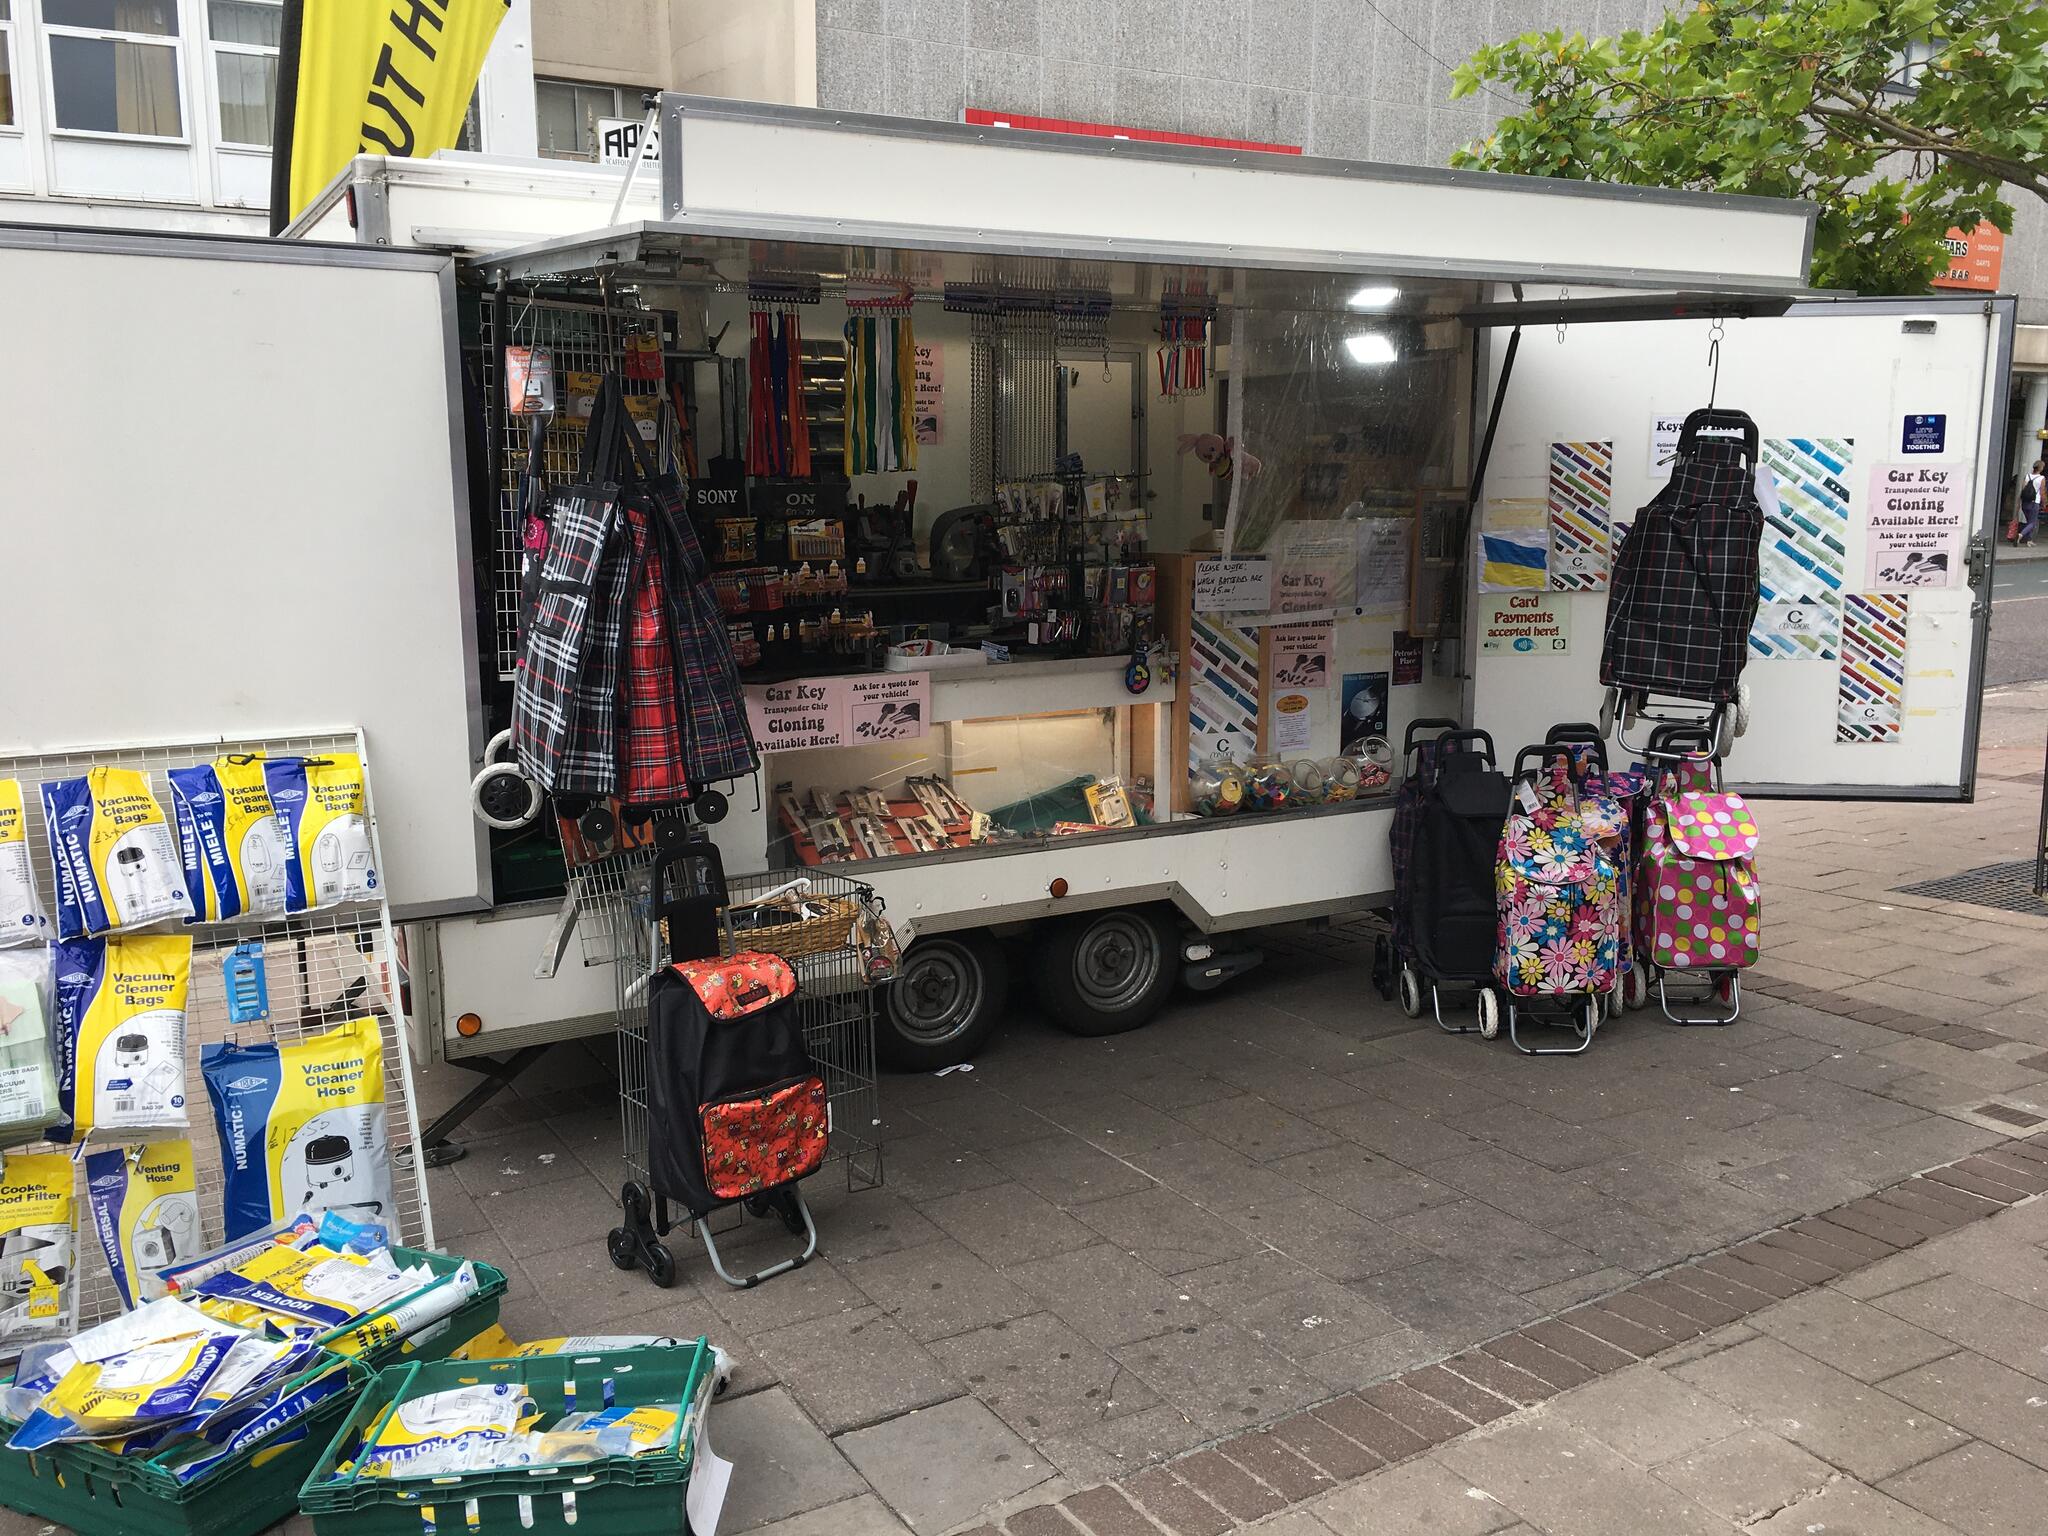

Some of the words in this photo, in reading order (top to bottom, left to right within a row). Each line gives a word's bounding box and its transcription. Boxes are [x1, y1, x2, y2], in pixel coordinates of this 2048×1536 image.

[359, 42, 425, 157] UT
[1951, 269, 1970, 280] BAR
[920, 384, 941, 392] Here!
[1888, 470, 1914, 482] Car
[1918, 469, 1949, 484] Key
[1932, 486, 1950, 494] Chip
[697, 489, 738, 505] SONY
[1887, 498, 1945, 513] Cloning
[1871, 516, 1925, 526] Available
[1927, 515, 1959, 525] Here!
[1889, 541, 1905, 549] your
[1908, 540, 1937, 548] vehicle!
[1281, 574, 1300, 587] Car
[1304, 574, 1325, 589] Key
[1509, 595, 1539, 608] Card
[1494, 612, 1554, 623] Payments
[1488, 627, 1531, 637] accepted
[1533, 626, 1559, 636] here!
[1778, 622, 1810, 630] CONDOR
[869, 683, 880, 691] for
[887, 681, 907, 690] quote
[909, 679, 919, 687] for
[766, 688, 792, 701] Car
[797, 685, 826, 701] Key
[863, 693, 879, 702] your
[881, 690, 909, 699] vehicle!
[764, 703, 809, 714] Transponder
[811, 703, 829, 711] Chip
[768, 717, 825, 733] Cloning
[756, 736, 807, 751] Available
[809, 734, 840, 746] Here!
[312, 784, 360, 794] Vacuum
[97, 796, 149, 808] Vacuum
[315, 793, 360, 803] Cleaner
[102, 804, 152, 817] Cleaner
[244, 804, 271, 814] Bags
[325, 802, 354, 812] Bags
[115, 812, 148, 825] Bags
[201, 819, 225, 866] MIELE
[278, 815, 295, 860] MIELE
[181, 825, 197, 870] MIELE
[66, 834, 97, 903] NUMATIC
[113, 973, 175, 982] Vacuum
[115, 984, 175, 994] Cleaner
[125, 995, 164, 1007] Bags
[302, 1057, 364, 1074] Vacuum
[306, 1069, 364, 1087] Cleaner
[317, 1086, 356, 1098] Hose
[234, 1110, 247, 1170] NUMATIC
[146, 1174, 173, 1183] Hose
[1, 1184, 48, 1195] Cooker
[0, 1195, 22, 1205] ood
[27, 1192, 62, 1201] Filter
[98, 1201, 119, 1267] UNIVERSAL
[251, 1290, 314, 1311] HOOVER
[622, 1417, 661, 1433] Vacuum
